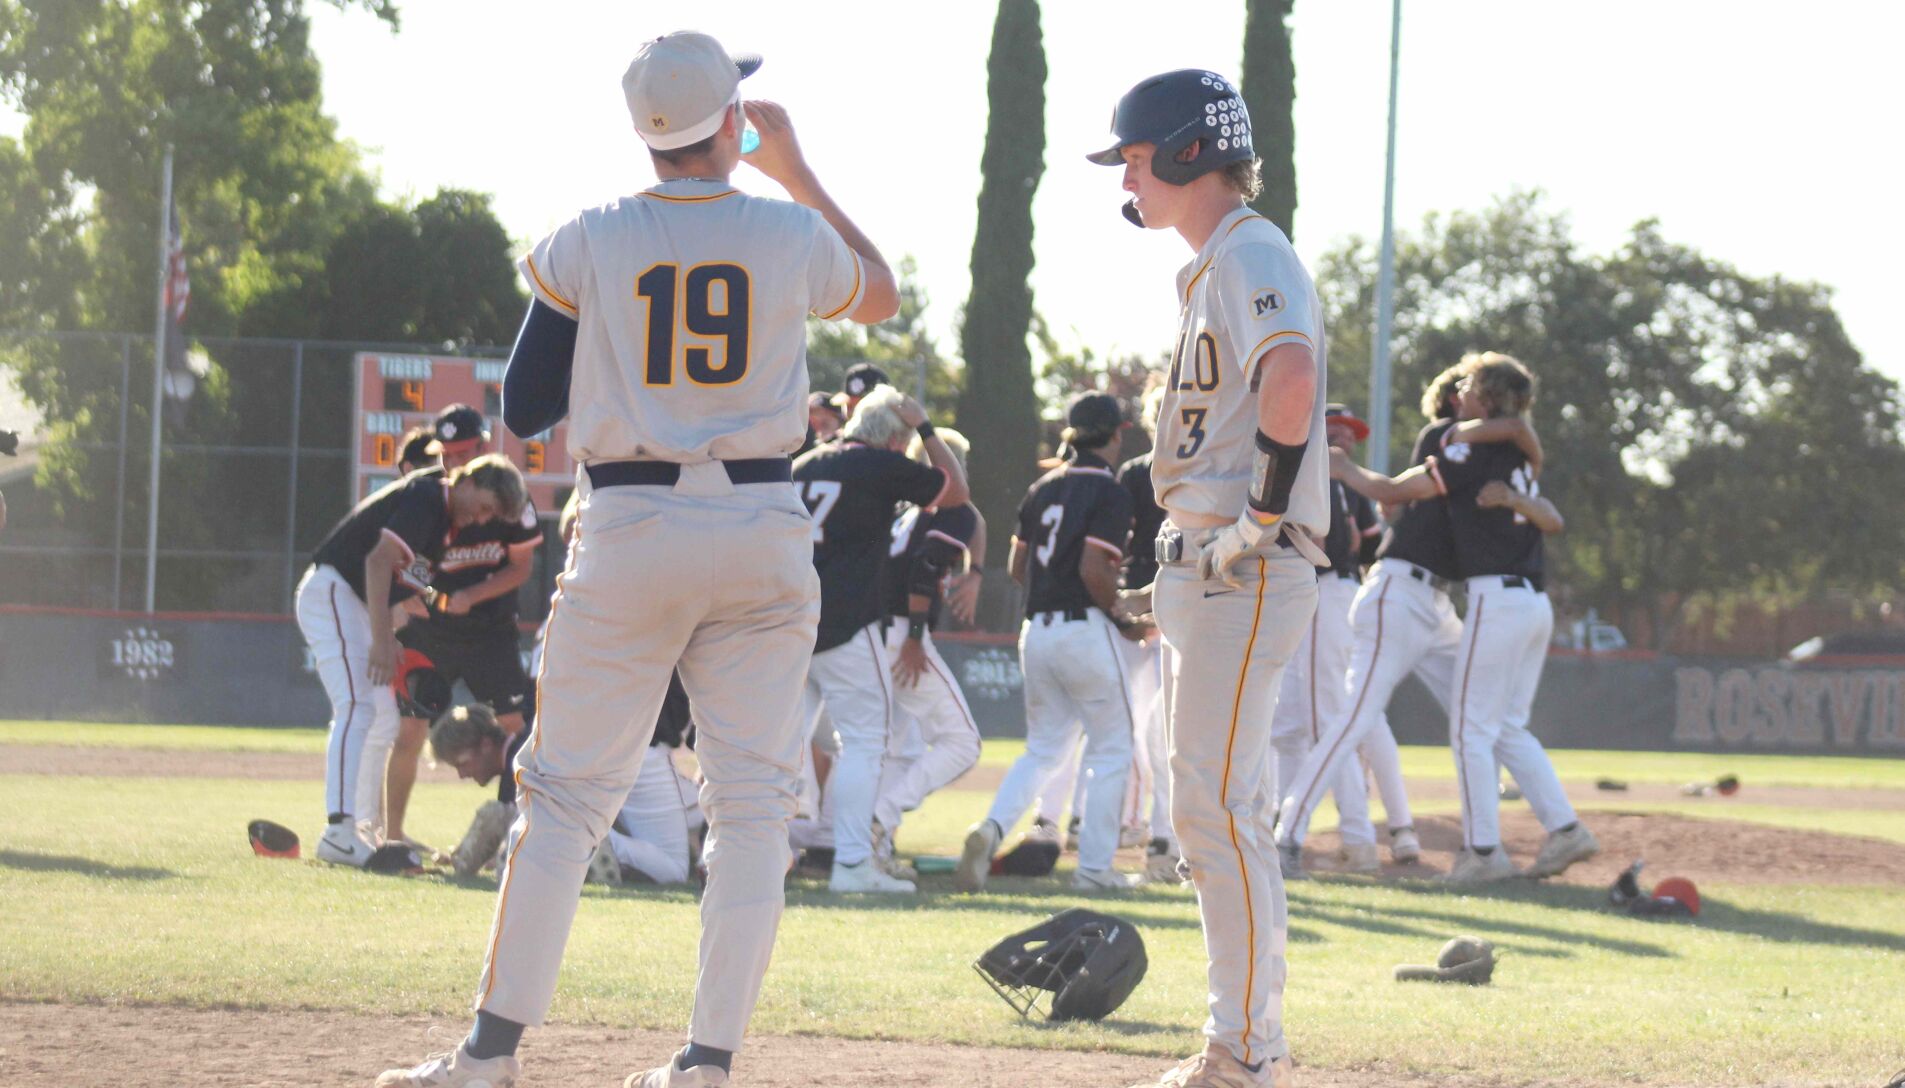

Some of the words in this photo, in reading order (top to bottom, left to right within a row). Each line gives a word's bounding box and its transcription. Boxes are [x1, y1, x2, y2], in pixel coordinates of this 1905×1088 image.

[1254, 293, 1279, 316] M
[634, 260, 753, 389] 19
[378, 356, 432, 380] TIGERS
[402, 380, 424, 412] 4
[1176, 408, 1208, 460] 3
[526, 441, 545, 475] 3
[1036, 503, 1064, 568] 3
[445, 540, 506, 564] seville
[111, 638, 175, 669] 1982
